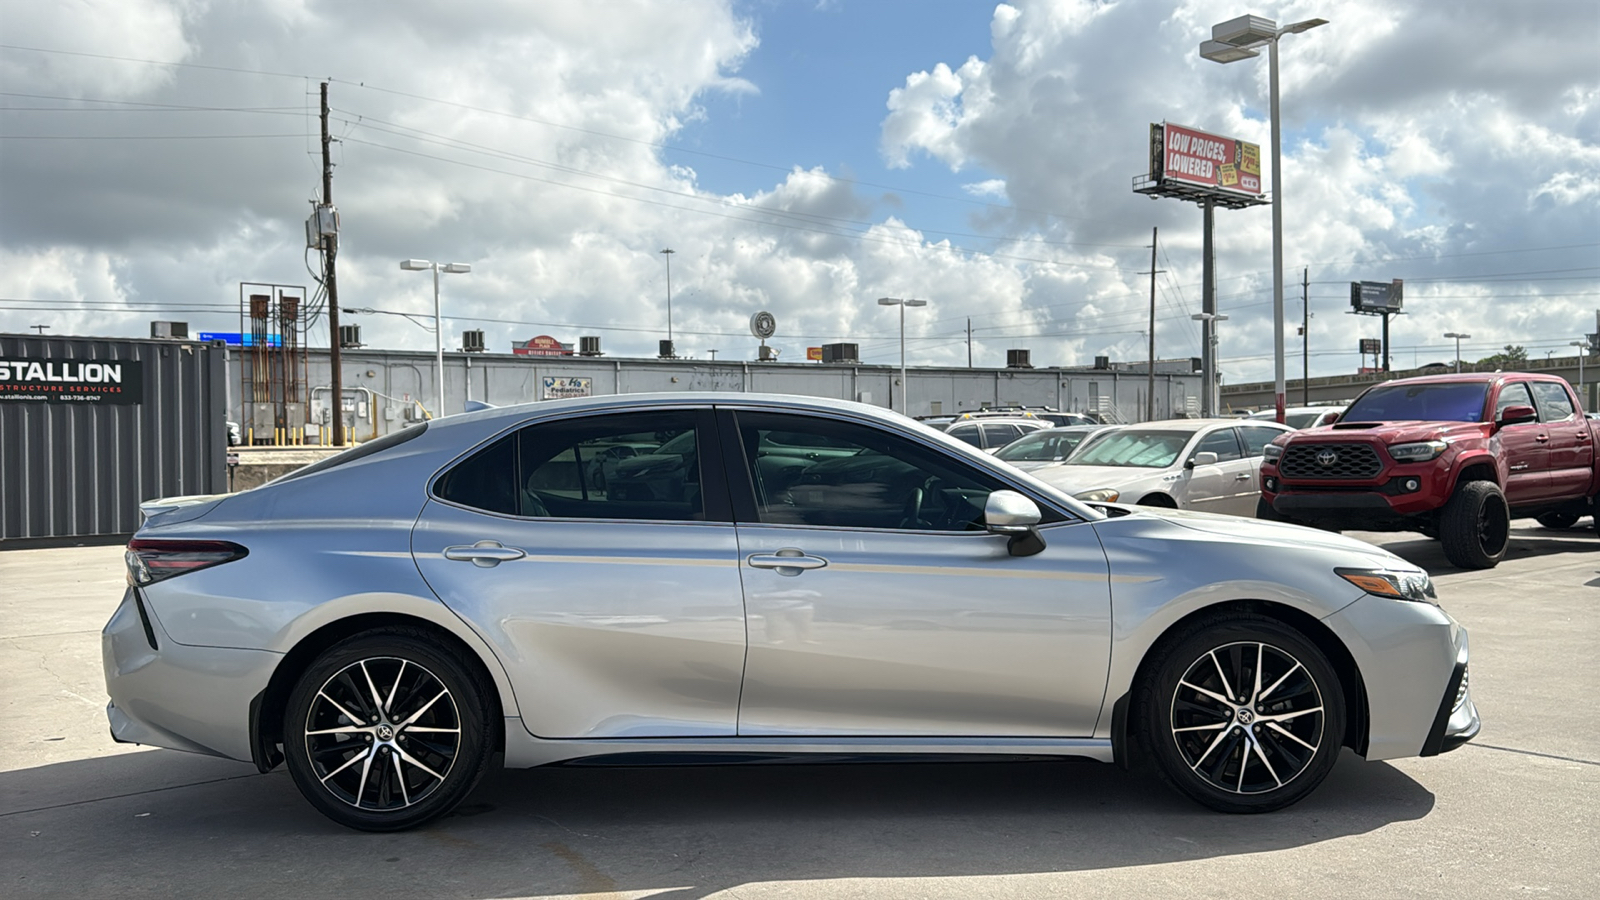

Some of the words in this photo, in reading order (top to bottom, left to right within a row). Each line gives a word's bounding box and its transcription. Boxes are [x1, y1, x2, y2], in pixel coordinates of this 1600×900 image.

[1168, 131, 1191, 153] LOW
[1190, 136, 1226, 164] PRICES,
[1168, 152, 1213, 178] LOWERED
[0, 360, 122, 383] STALLION
